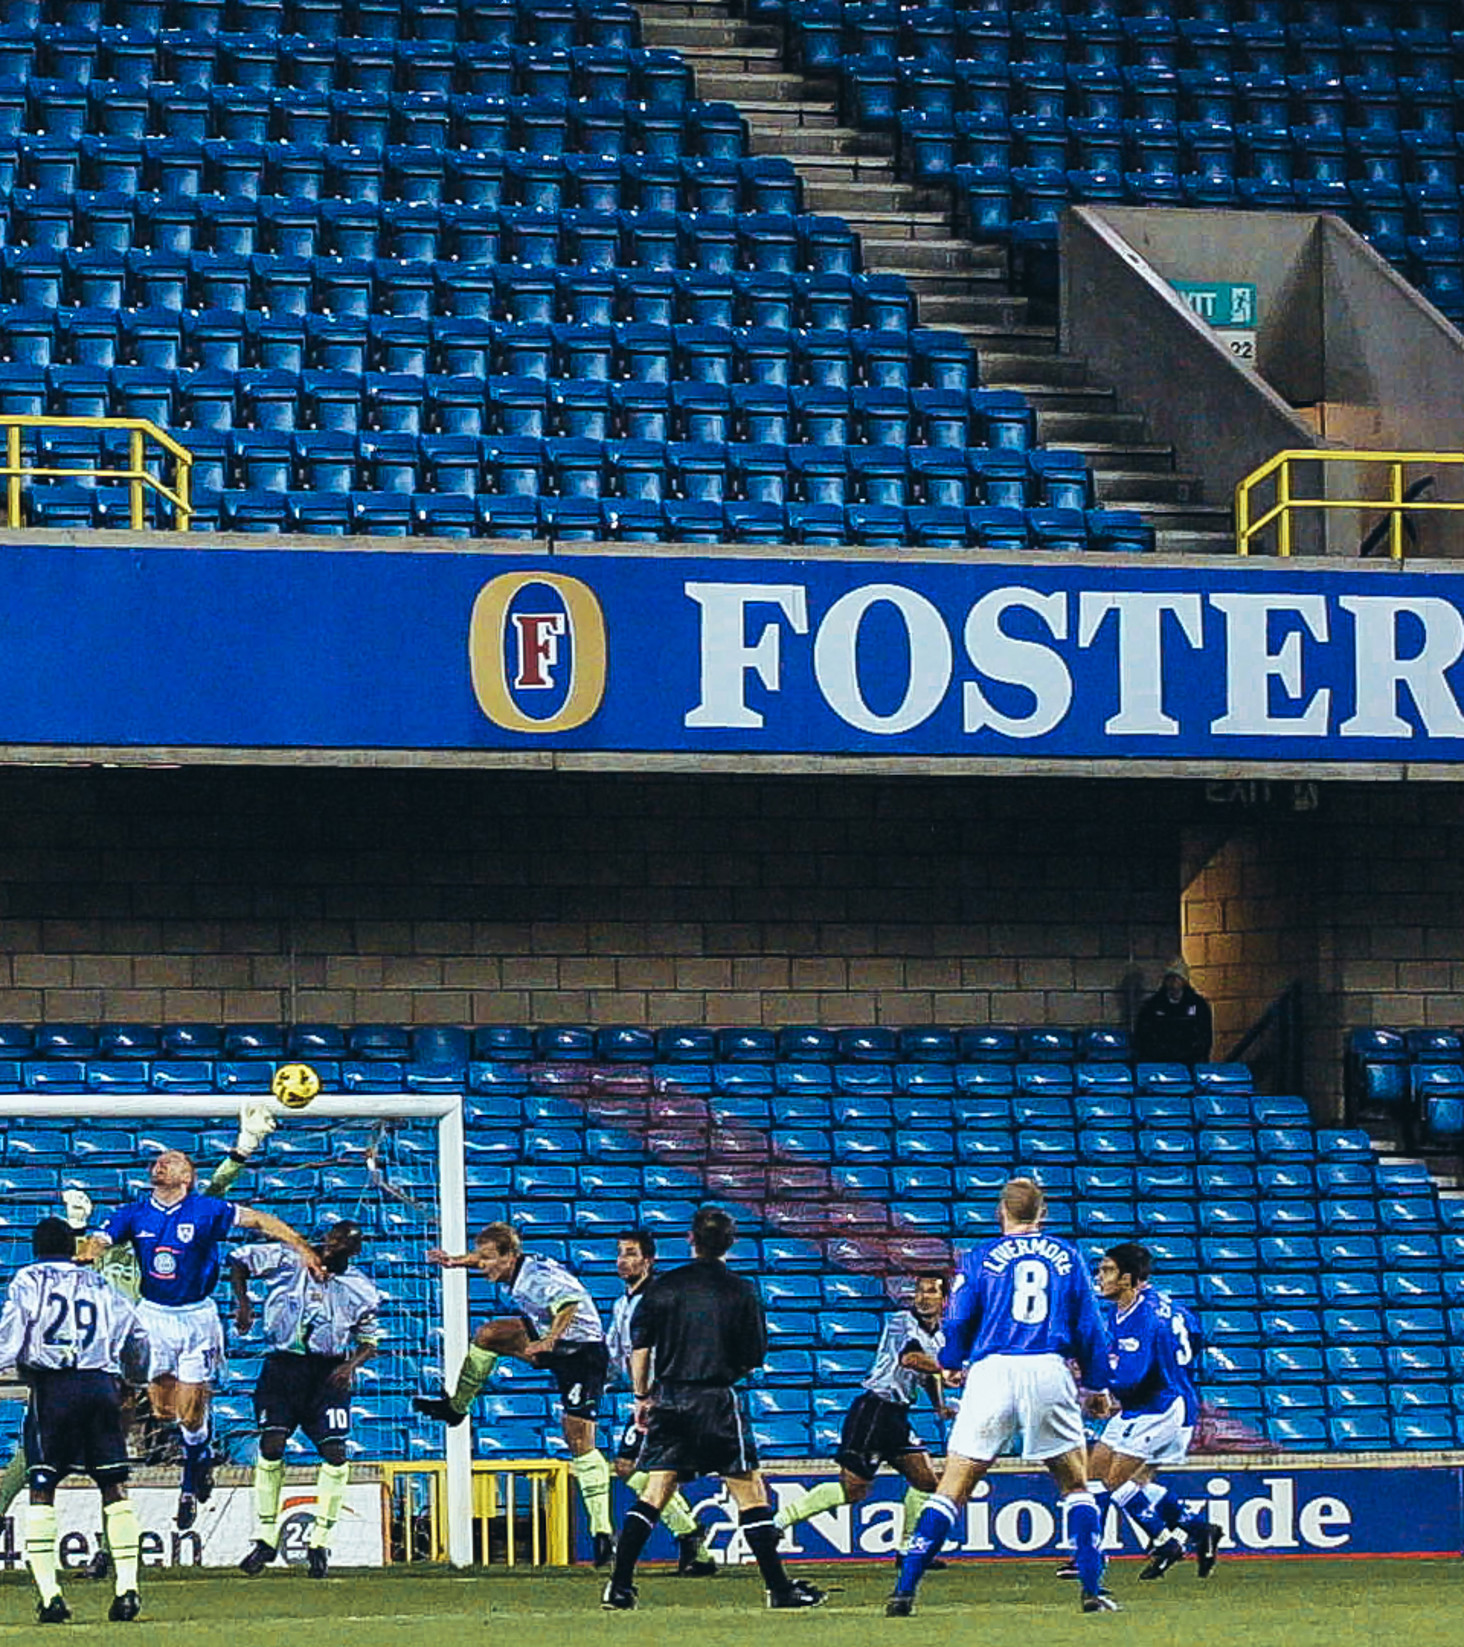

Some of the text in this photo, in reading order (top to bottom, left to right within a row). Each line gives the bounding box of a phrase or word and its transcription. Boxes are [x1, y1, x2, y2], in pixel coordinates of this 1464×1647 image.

[513, 612, 565, 690] F
[684, 580, 1464, 738] FOSTER
[983, 1236, 1073, 1277] LIVERMORE
[1011, 1259, 1049, 1325] 8
[43, 1292, 98, 1351] 29
[325, 1408, 348, 1429] 10
[568, 1383, 583, 1406] 4
[286, 1522, 316, 1548] 24
